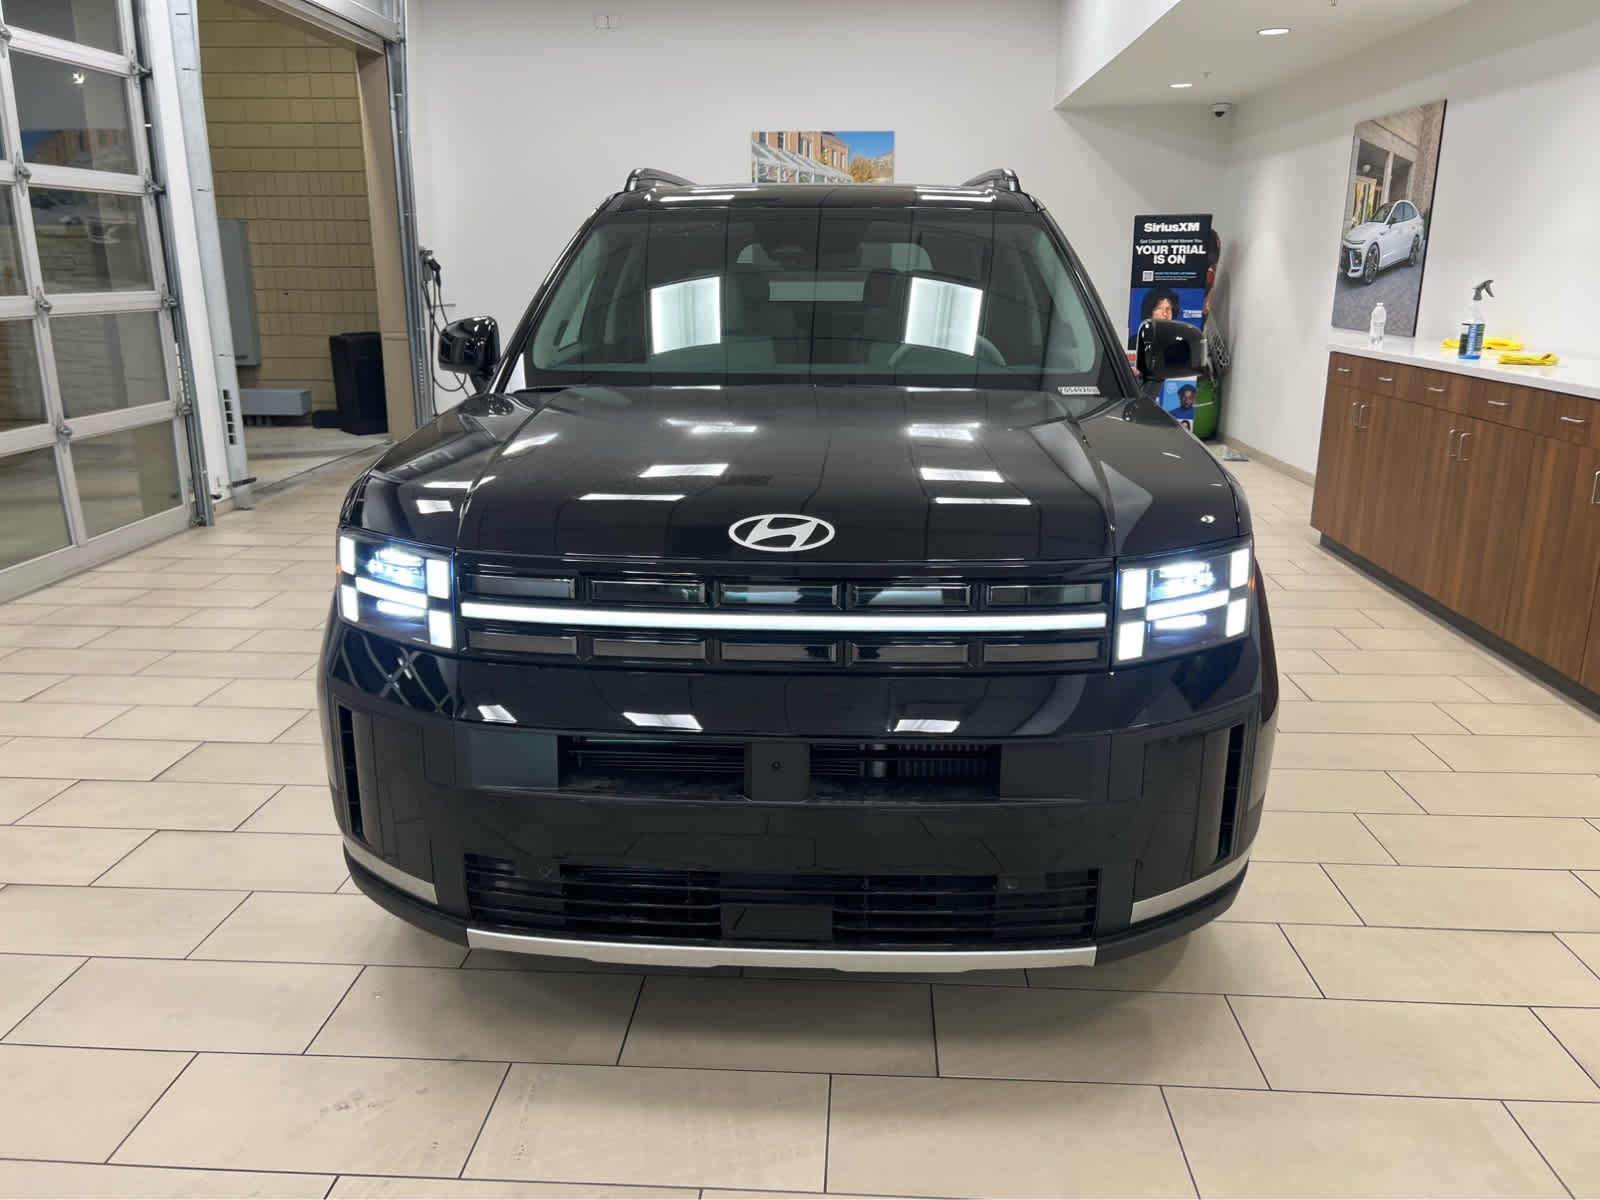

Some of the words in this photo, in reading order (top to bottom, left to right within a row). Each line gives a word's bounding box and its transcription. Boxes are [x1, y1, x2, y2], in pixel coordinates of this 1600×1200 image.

[1144, 222, 1200, 232] SiriusXM
[1136, 245, 1168, 255] YOUR
[1171, 245, 1206, 254] TRIAL
[1153, 255, 1165, 264] IS
[1167, 255, 1186, 264] ON
